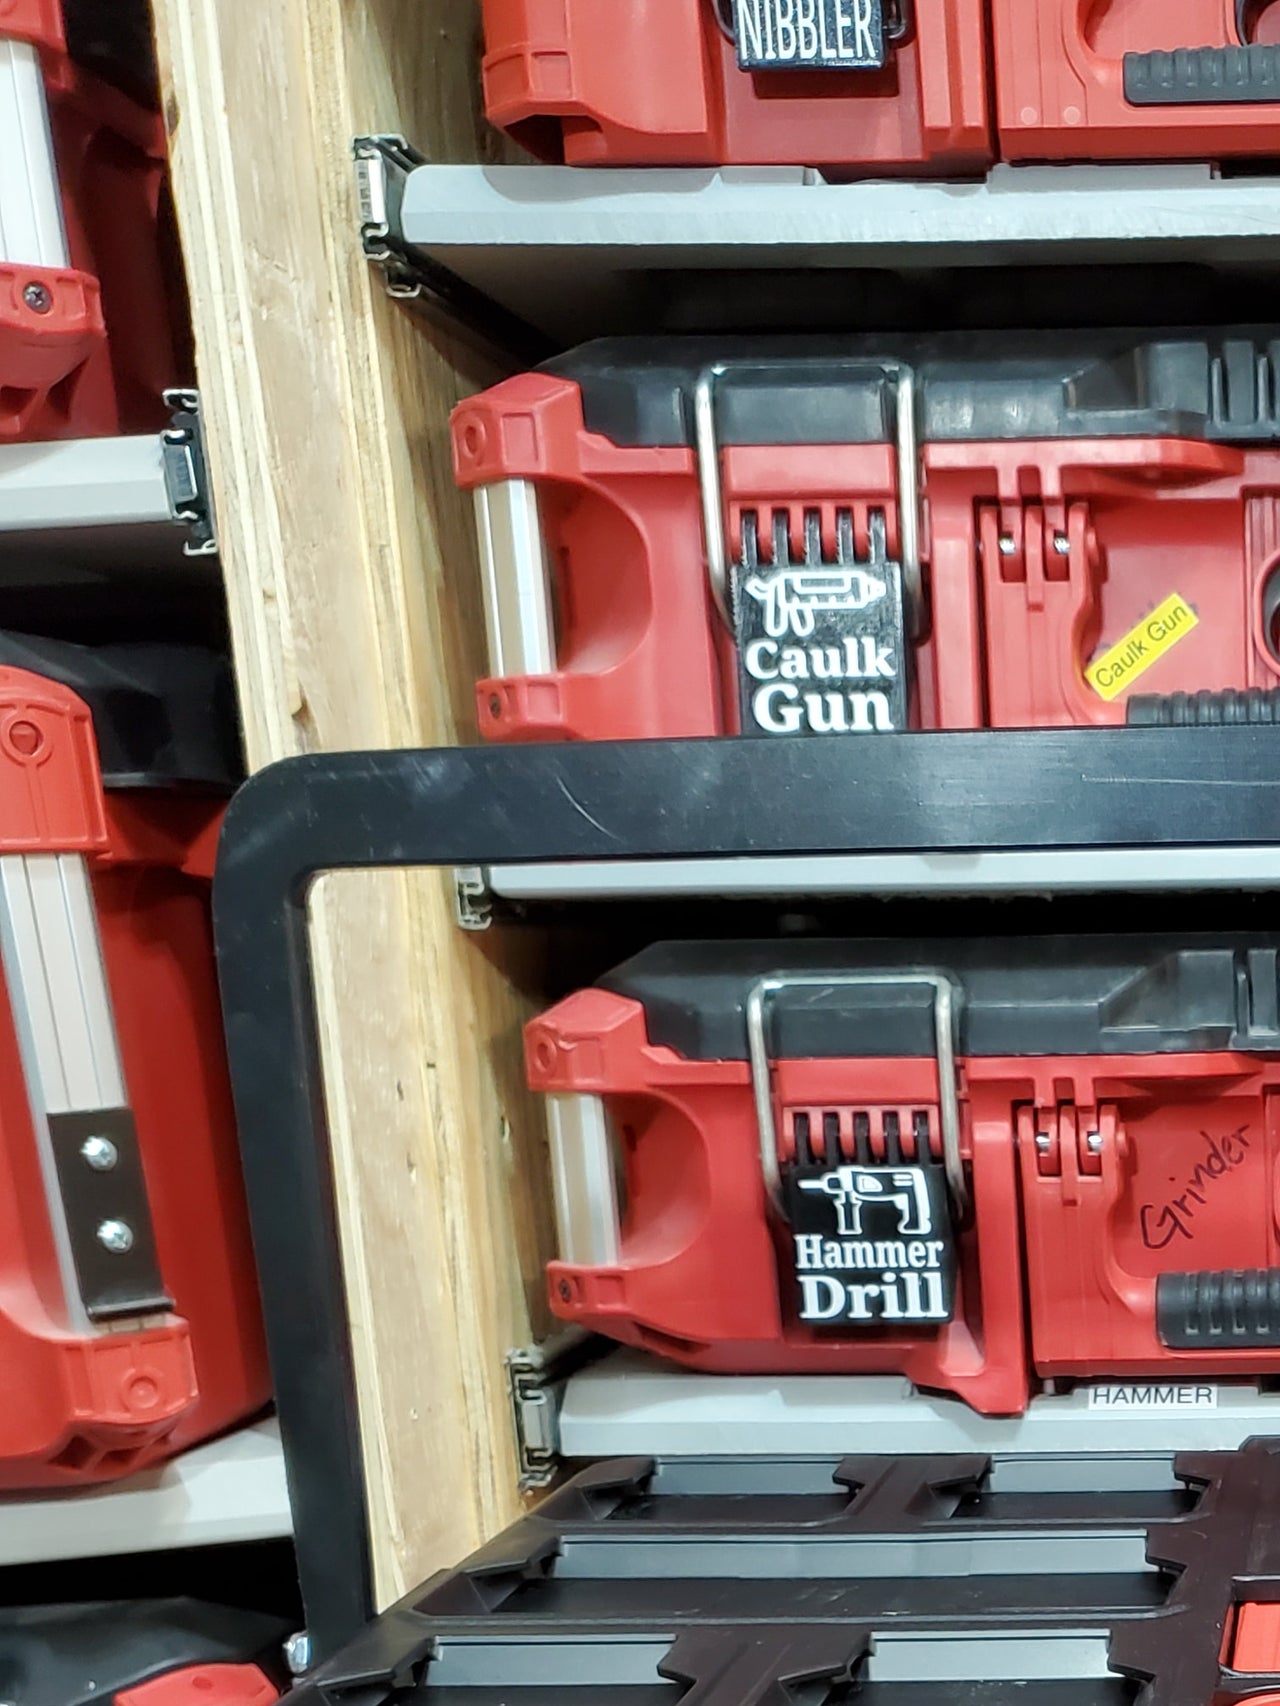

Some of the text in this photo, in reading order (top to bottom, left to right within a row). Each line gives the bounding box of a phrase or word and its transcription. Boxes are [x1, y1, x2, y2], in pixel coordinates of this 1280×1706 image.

[738, 0, 876, 59] NIBBLER
[744, 636, 896, 680] Caulk
[1095, 605, 1188, 687] Caulk Gun
[753, 683, 895, 733] Gun
[1140, 1124, 1250, 1249] Grinder
[793, 1233, 945, 1269] Hammer
[796, 1271, 950, 1319] Drill
[1092, 1386, 1213, 1405] HAMMER
